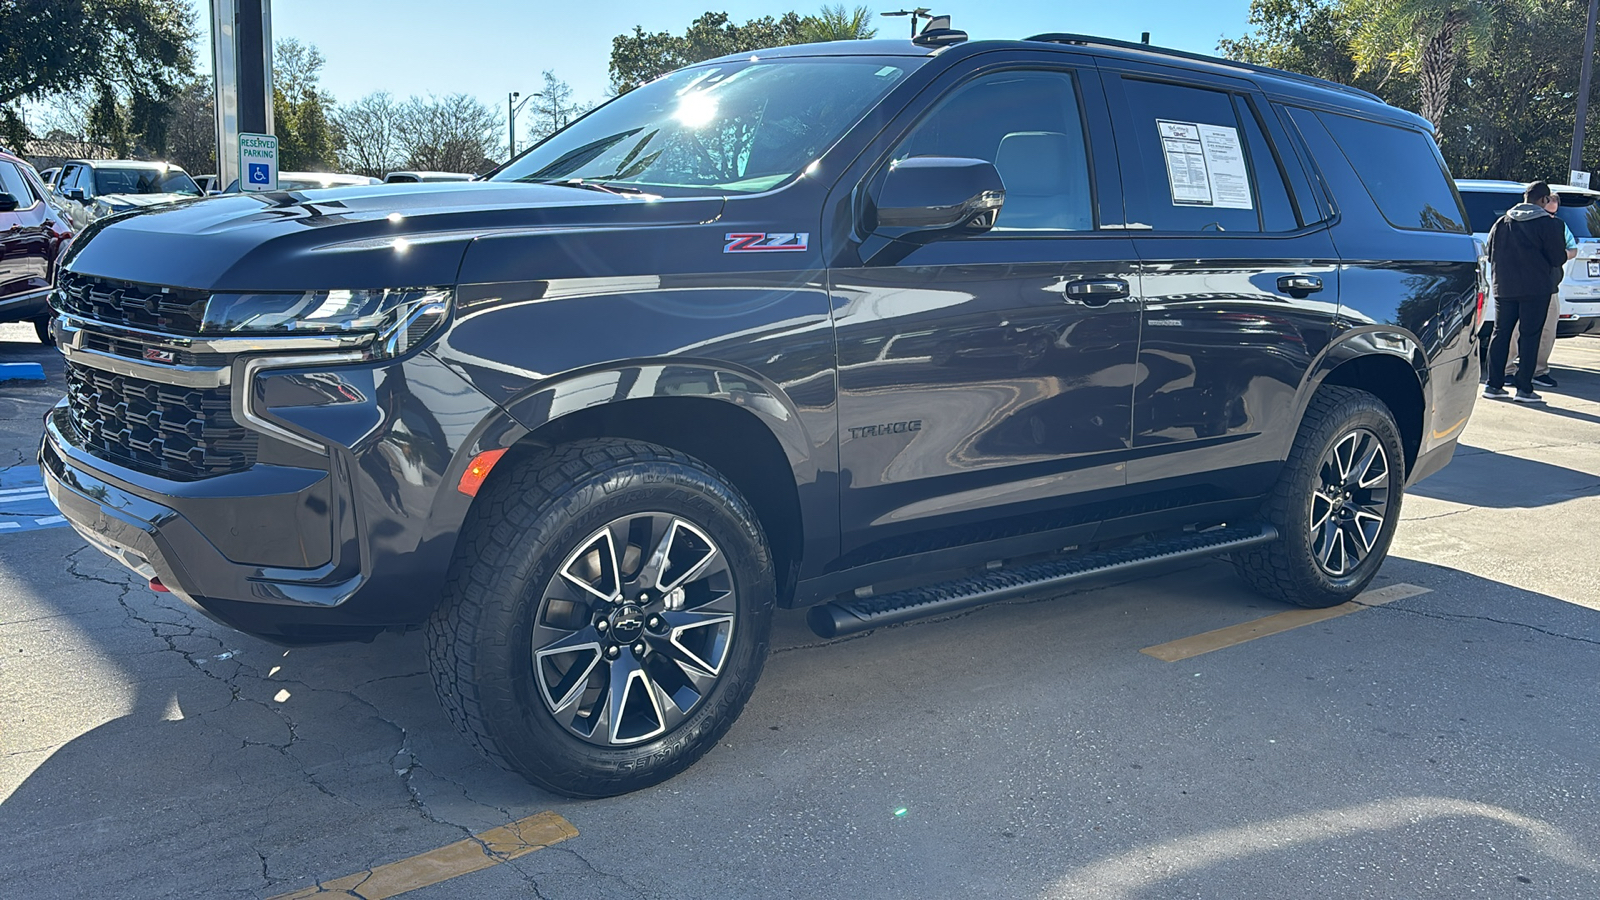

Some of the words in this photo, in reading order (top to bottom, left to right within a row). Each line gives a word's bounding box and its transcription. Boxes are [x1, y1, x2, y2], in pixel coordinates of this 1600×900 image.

[241, 139, 276, 149] RESERVED
[243, 149, 274, 158] PARKING
[723, 232, 809, 253] Z71
[848, 419, 922, 439] TAHOE
[512, 559, 545, 644] OPEN
[546, 488, 657, 559] COUNTRY
[698, 667, 745, 737] TOYO
[615, 731, 697, 771] TIRES
